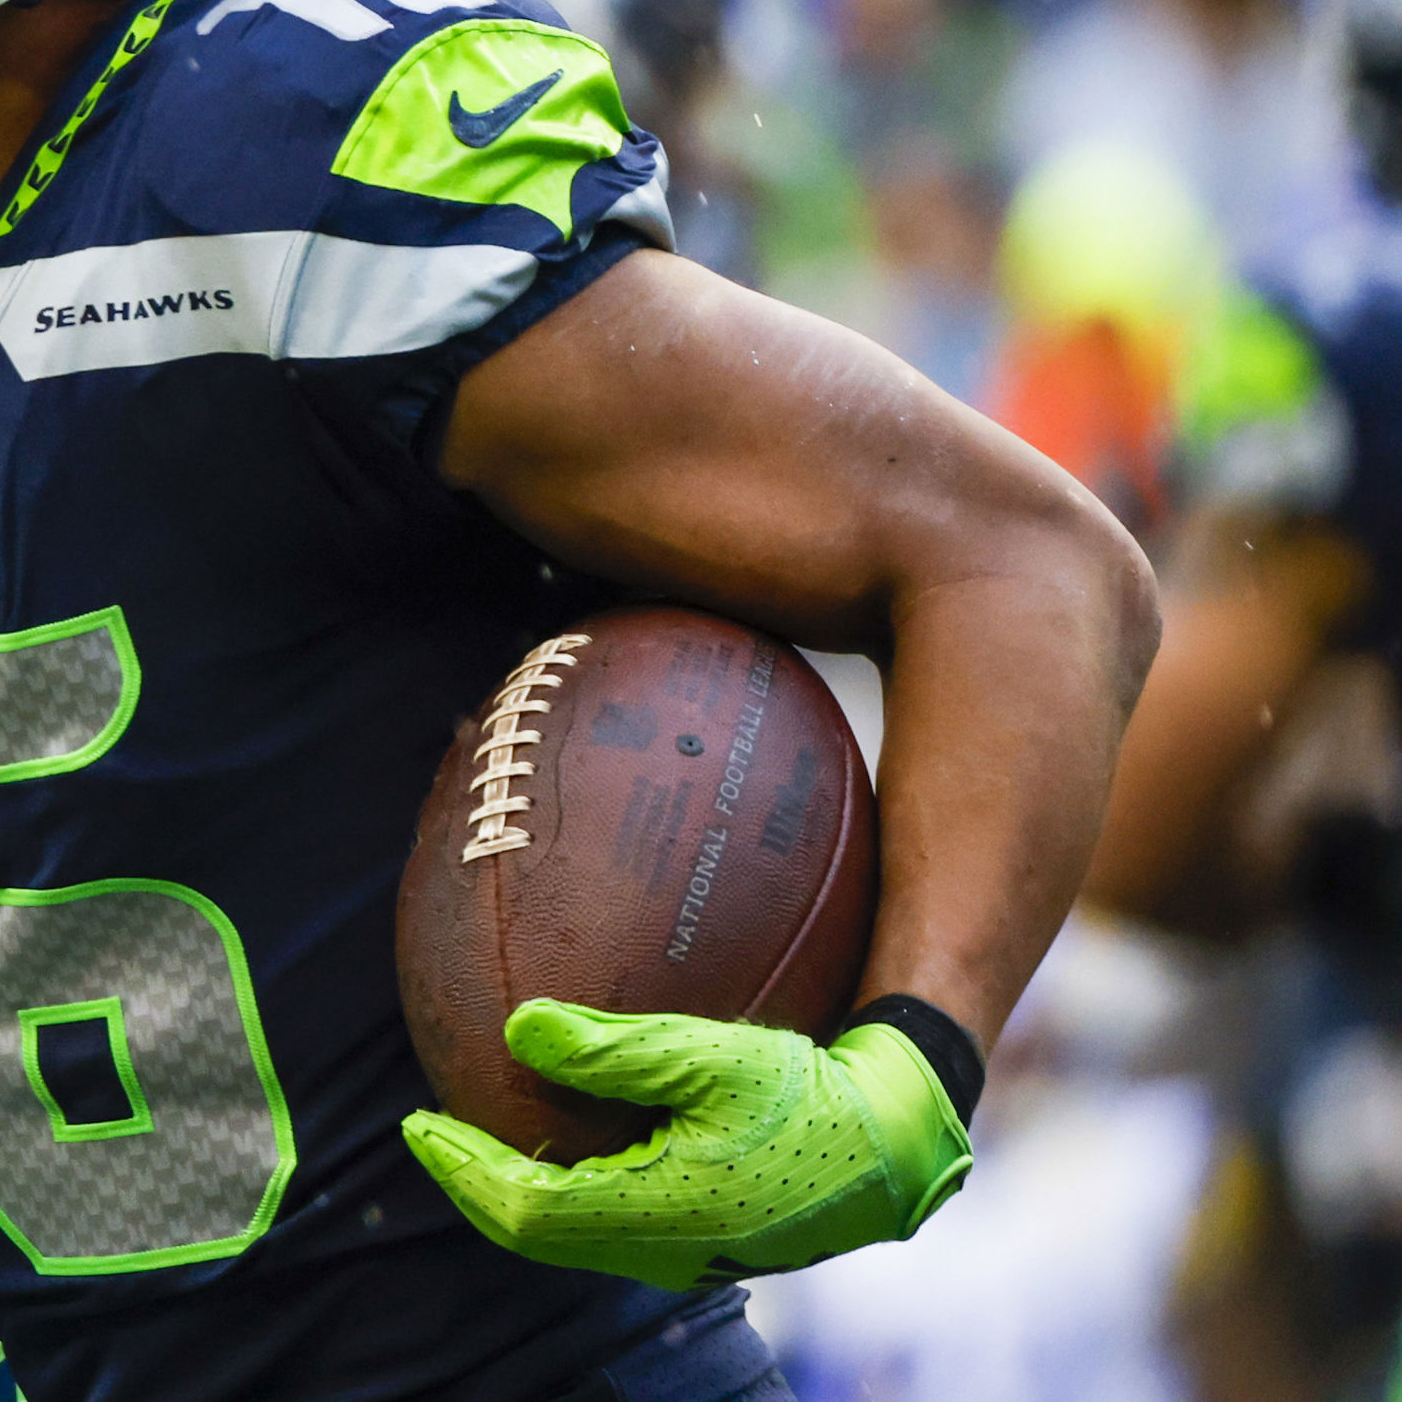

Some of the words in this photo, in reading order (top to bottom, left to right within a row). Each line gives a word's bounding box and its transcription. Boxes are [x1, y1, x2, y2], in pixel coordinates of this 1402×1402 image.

[34, 289, 235, 334] SEAHAWKS
[665, 827, 729, 962] NATIONAL
[714, 702, 765, 816] FOOTBALL
